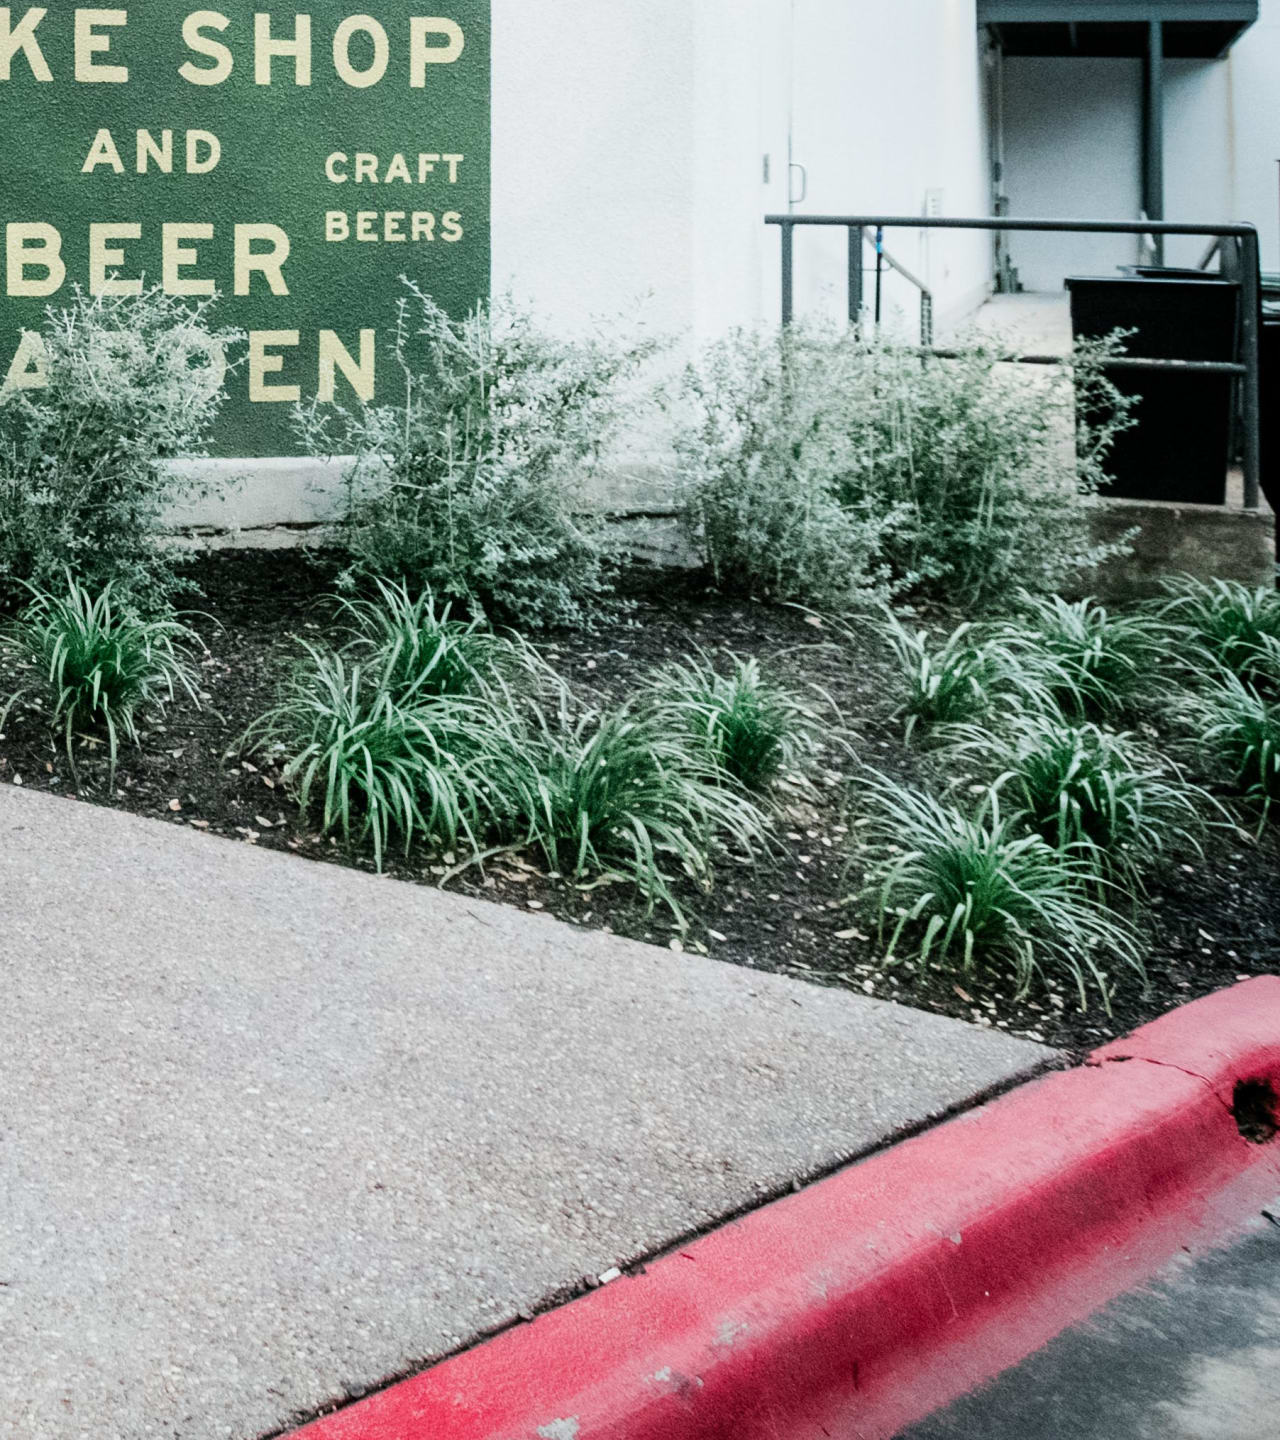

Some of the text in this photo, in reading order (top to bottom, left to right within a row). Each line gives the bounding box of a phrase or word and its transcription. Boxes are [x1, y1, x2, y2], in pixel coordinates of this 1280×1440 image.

[177, 10, 465, 89] SHOP
[81, 128, 221, 174] AND
[325, 151, 464, 184] CRAFT
[325, 210, 464, 242] BEERS
[6, 222, 291, 297] BEER
